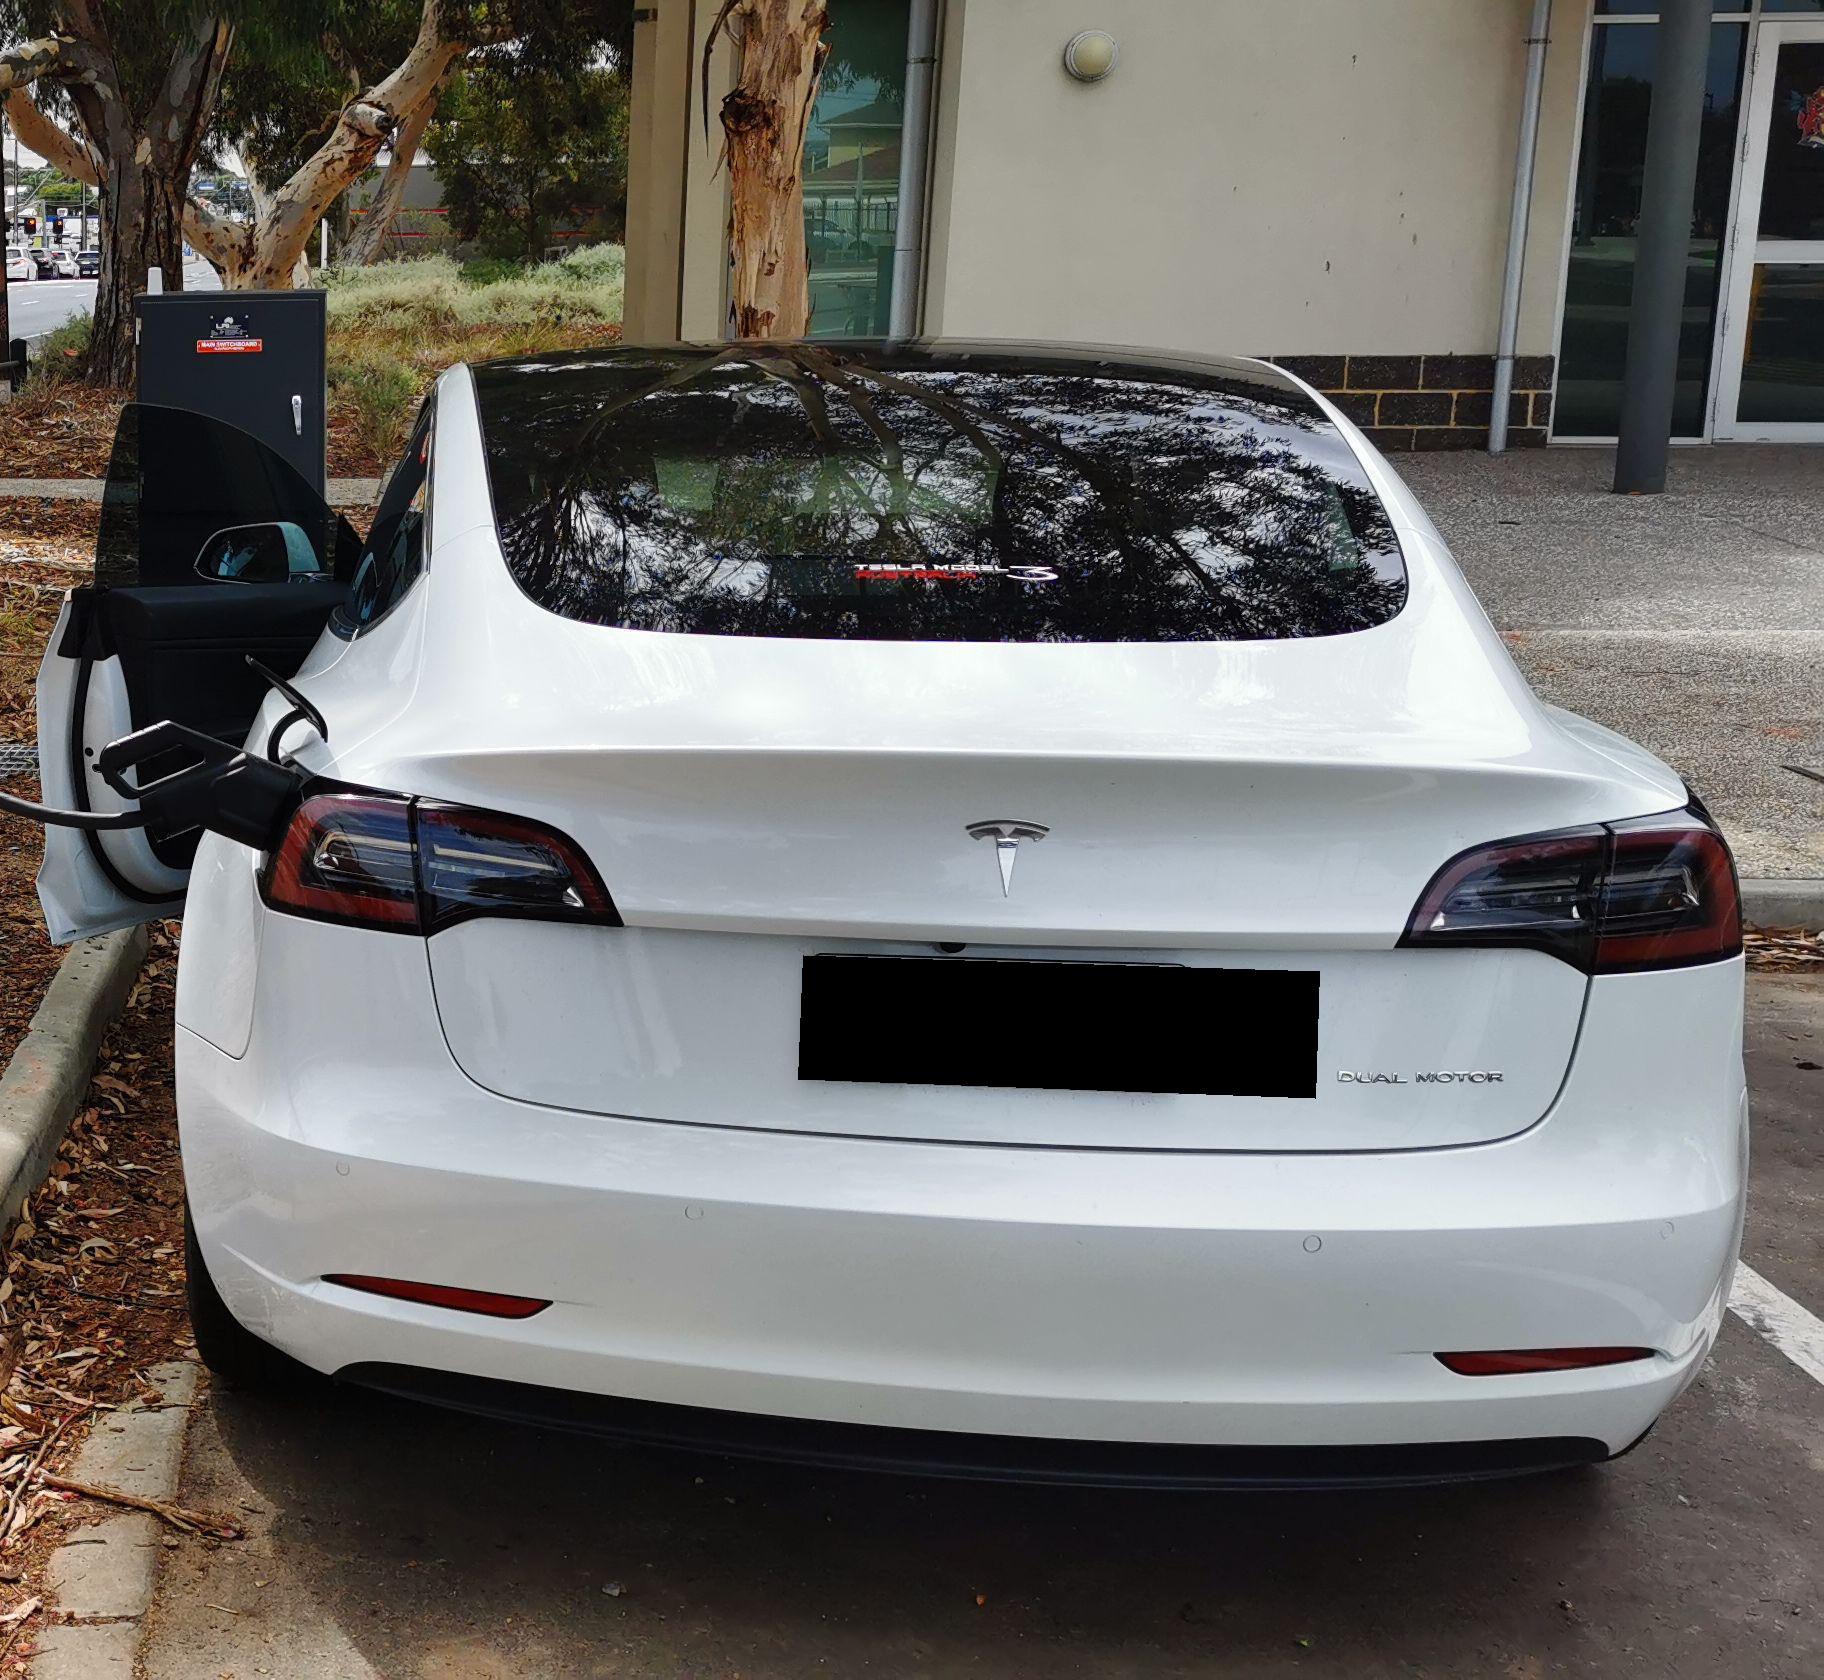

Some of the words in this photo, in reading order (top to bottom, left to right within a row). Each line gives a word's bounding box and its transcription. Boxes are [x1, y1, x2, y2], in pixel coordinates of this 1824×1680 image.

[854, 563, 926, 571] TESLA
[933, 563, 1009, 573] MODEL
[1005, 565, 1059, 581] 3
[1337, 1070, 1408, 1084] DUAL
[1415, 1070, 1504, 1084] MOTOR
